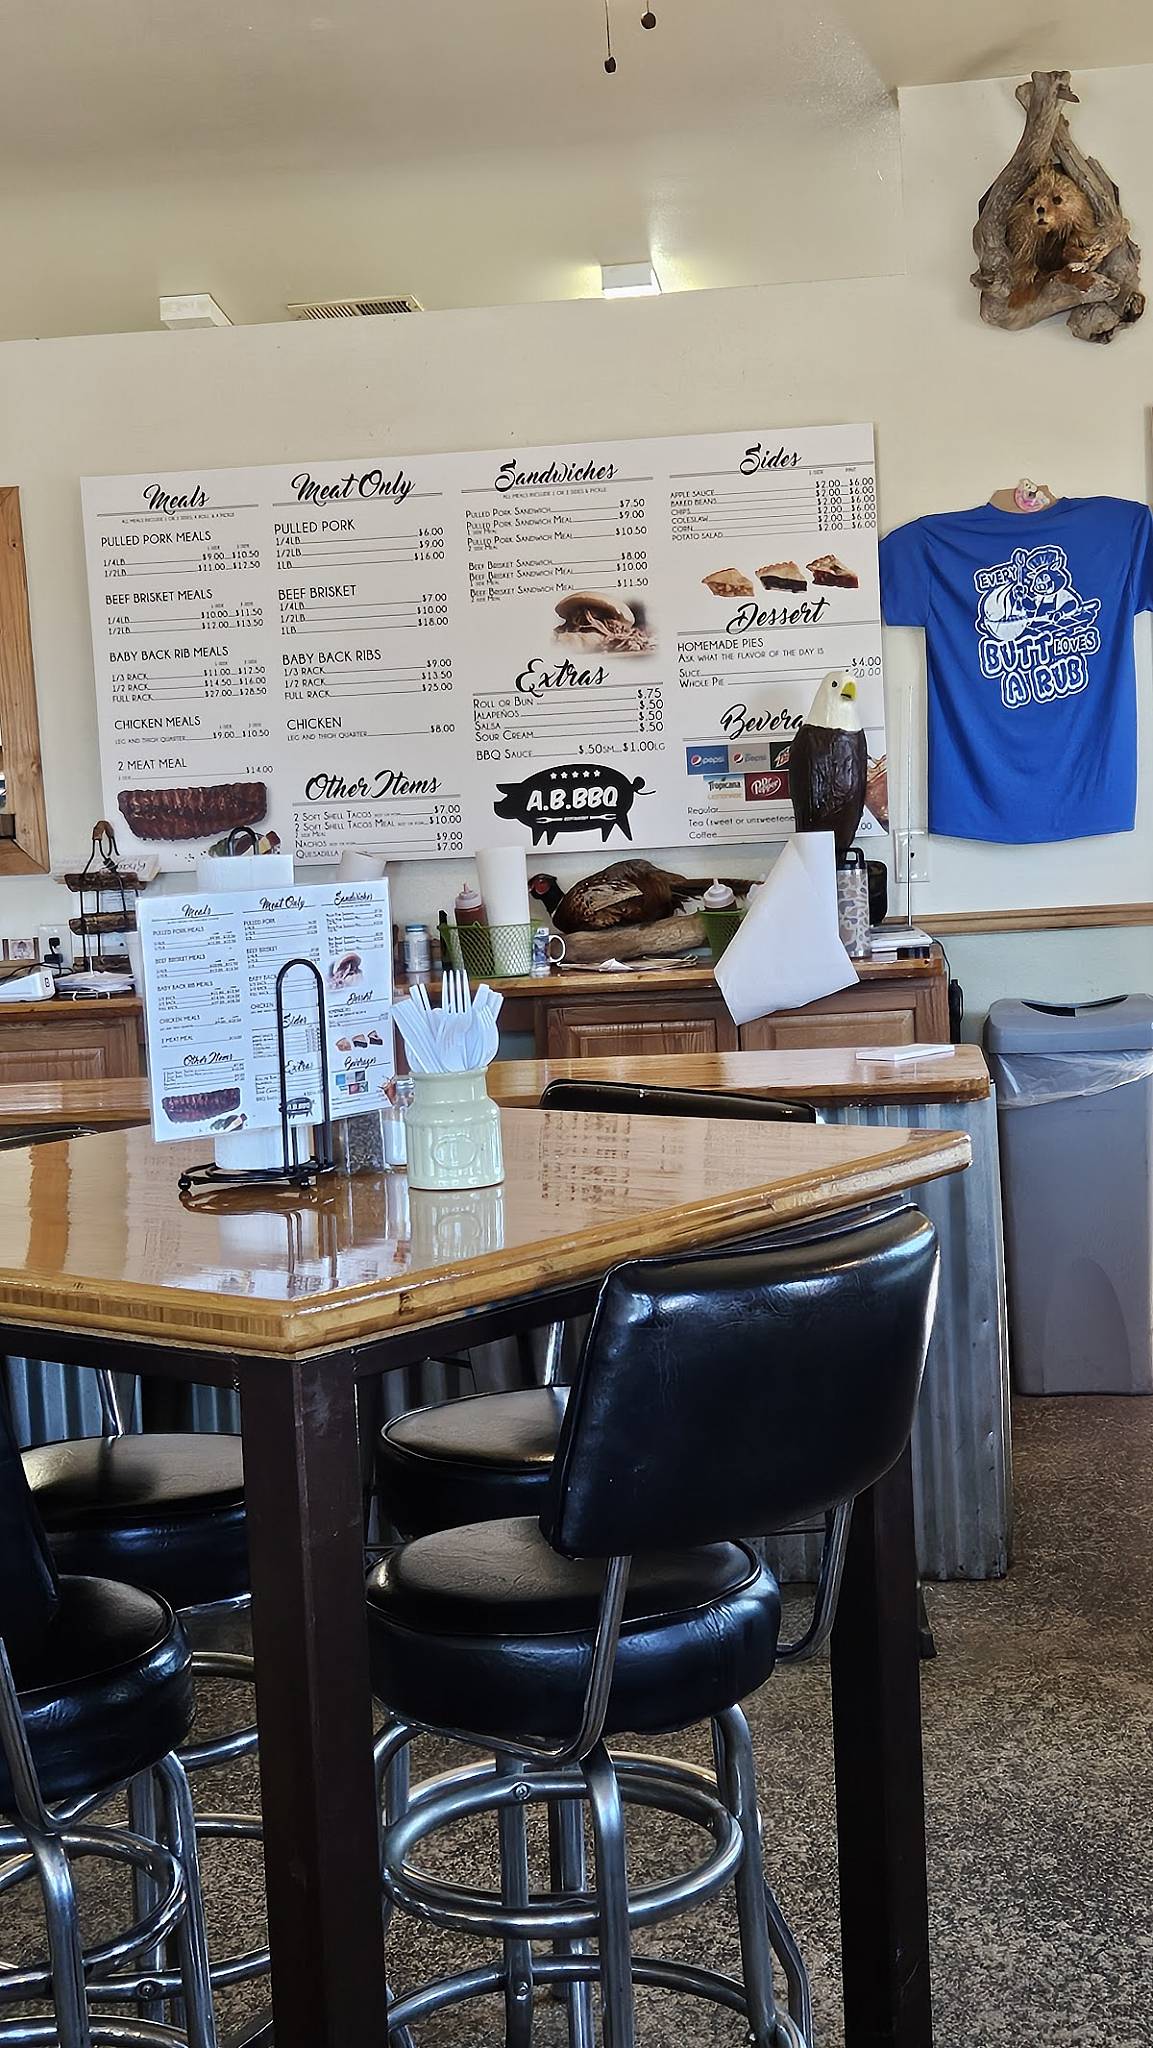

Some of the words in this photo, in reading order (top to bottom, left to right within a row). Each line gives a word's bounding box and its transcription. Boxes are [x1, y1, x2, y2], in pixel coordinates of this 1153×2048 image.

[739, 443, 802, 475] Sides
[495, 459, 618, 492] Sandwiches
[815, 480, 840, 489] $2.00
[849, 477, 873, 486] $6.00
[291, 473, 359, 507] Meat
[359, 470, 416, 505] Only
[143, 484, 210, 515] Meals
[619, 499, 645, 508] $7.50
[619, 510, 645, 519] $9.00
[274, 522, 318, 535] PULLED
[322, 519, 356, 532] PORK
[615, 526, 647, 536] $10.50
[101, 534, 139, 547] PULLED
[143, 533, 173, 545] PORK
[176, 530, 211, 542] MEALS
[275, 537, 301, 546] 1/4LB
[419, 527, 443, 536] $6.00
[202, 552, 224, 560] $9.00
[232, 550, 259, 558] $10.50
[277, 549, 301, 558] 1/2LB
[419, 539, 444, 548] $9.00
[621, 551, 646, 560] $8.00
[198, 563, 226, 571] $11.00
[233, 561, 260, 569] $12.50
[277, 561, 293, 570] 1LB
[414, 551, 444, 560] $16.00
[616, 562, 647, 571] $10.00
[617, 578, 648, 587] $11.50
[980, 566, 1017, 587] EVERY
[105, 594, 130, 605] BEEF
[133, 591, 174, 603] BRISKET
[178, 589, 213, 600] MEALS
[278, 588, 306, 601] BEEF
[310, 584, 356, 598] BRISKET
[280, 602, 305, 611] 1/4LB
[422, 593, 447, 602] $7.00
[201, 610, 228, 618] $10.00
[235, 608, 263, 616] $11.50
[280, 614, 306, 623] 1/2LB
[417, 605, 448, 614] $10.00
[726, 597, 830, 635] Dessert
[202, 621, 229, 629] $12.00
[281, 627, 296, 635] 1LB
[418, 617, 448, 626] $18.00
[677, 639, 739, 652] HOMEMADE
[742, 638, 764, 647] PIES
[985, 634, 1052, 671] BUTT
[1055, 633, 1095, 655] LOVES
[109, 652, 138, 662] BABY
[141, 650, 171, 661] BACK
[174, 649, 190, 659] RIB
[193, 646, 229, 657] MEALS
[282, 653, 314, 665] BABY
[318, 651, 353, 664] BACK
[356, 649, 382, 661] RIBS
[851, 656, 881, 667] $4.00
[285, 668, 299, 677] 1/3
[301, 667, 325, 675] RACK
[427, 659, 452, 668] $9.00
[285, 680, 299, 688] 1/2
[302, 678, 326, 687] RACK
[422, 671, 452, 680] $13.50
[515, 658, 610, 698] Extras
[1007, 673, 1026, 702] A
[1035, 658, 1081, 696] RUB
[285, 692, 304, 700] FULL
[307, 690, 330, 699] RACK
[422, 683, 453, 692] $25.00
[639, 700, 663, 710] $.50
[114, 718, 163, 730] CHICKEN
[166, 716, 201, 727] MEALS
[287, 717, 342, 731] CHICKEN
[430, 724, 455, 733] $8.00
[720, 704, 803, 740] Bevera
[213, 731, 234, 739] $9.00
[242, 729, 269, 738] $10.50
[476, 751, 501, 761] BBQ
[118, 761, 123, 771] 2
[127, 760, 155, 770] MEAT
[159, 758, 187, 768] MEAL
[305, 773, 372, 800] Other
[371, 769, 441, 799] Items
[709, 781, 741, 791] Tropicana
[526, 786, 618, 811] A.B.BBQ
[434, 805, 460, 814] $7.00
[429, 815, 462, 825] $10.00
[689, 819, 703, 827] Tea
[437, 832, 463, 841] $9.00
[689, 831, 717, 840] Coffee
[437, 841, 463, 850] $7.00
